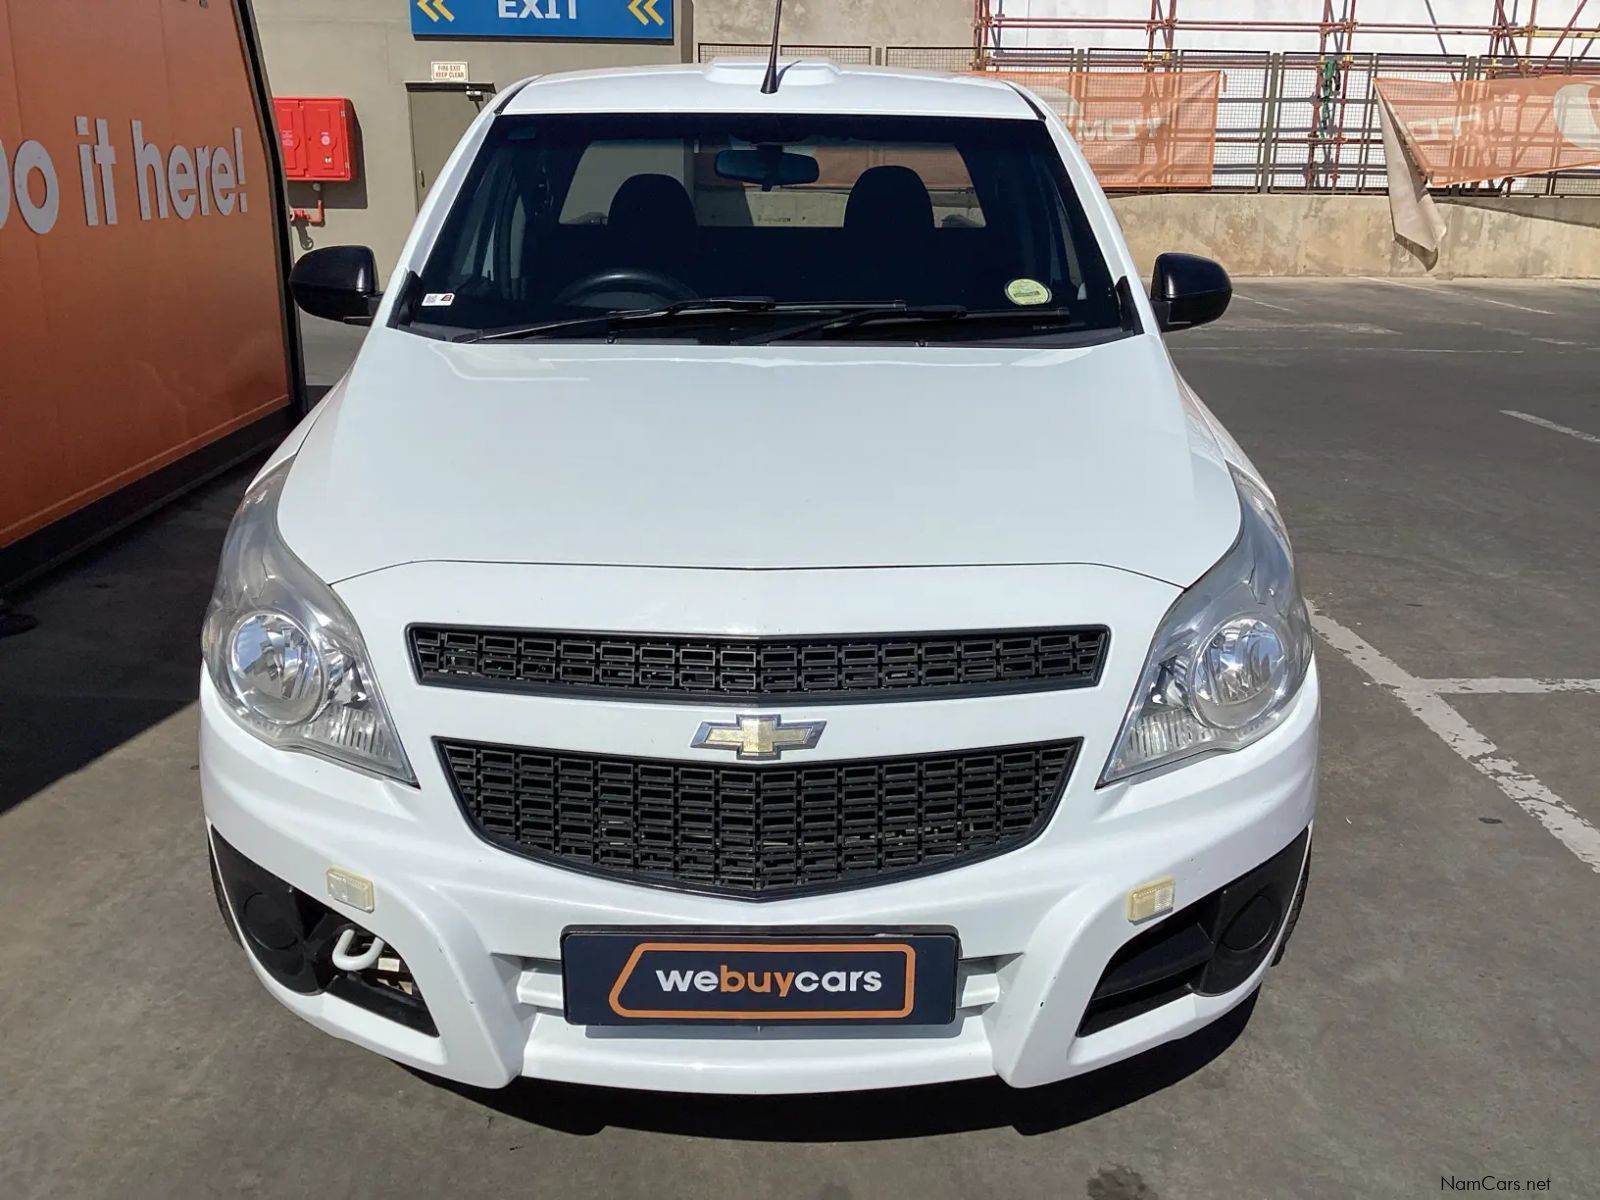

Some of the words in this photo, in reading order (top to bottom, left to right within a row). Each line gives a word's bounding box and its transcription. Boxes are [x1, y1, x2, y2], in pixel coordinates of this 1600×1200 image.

[498, 0, 577, 19] EXIT
[0, 138, 60, 235] o
[75, 115, 118, 226] it
[130, 119, 248, 221] here!
[656, 964, 882, 998] webuycars
